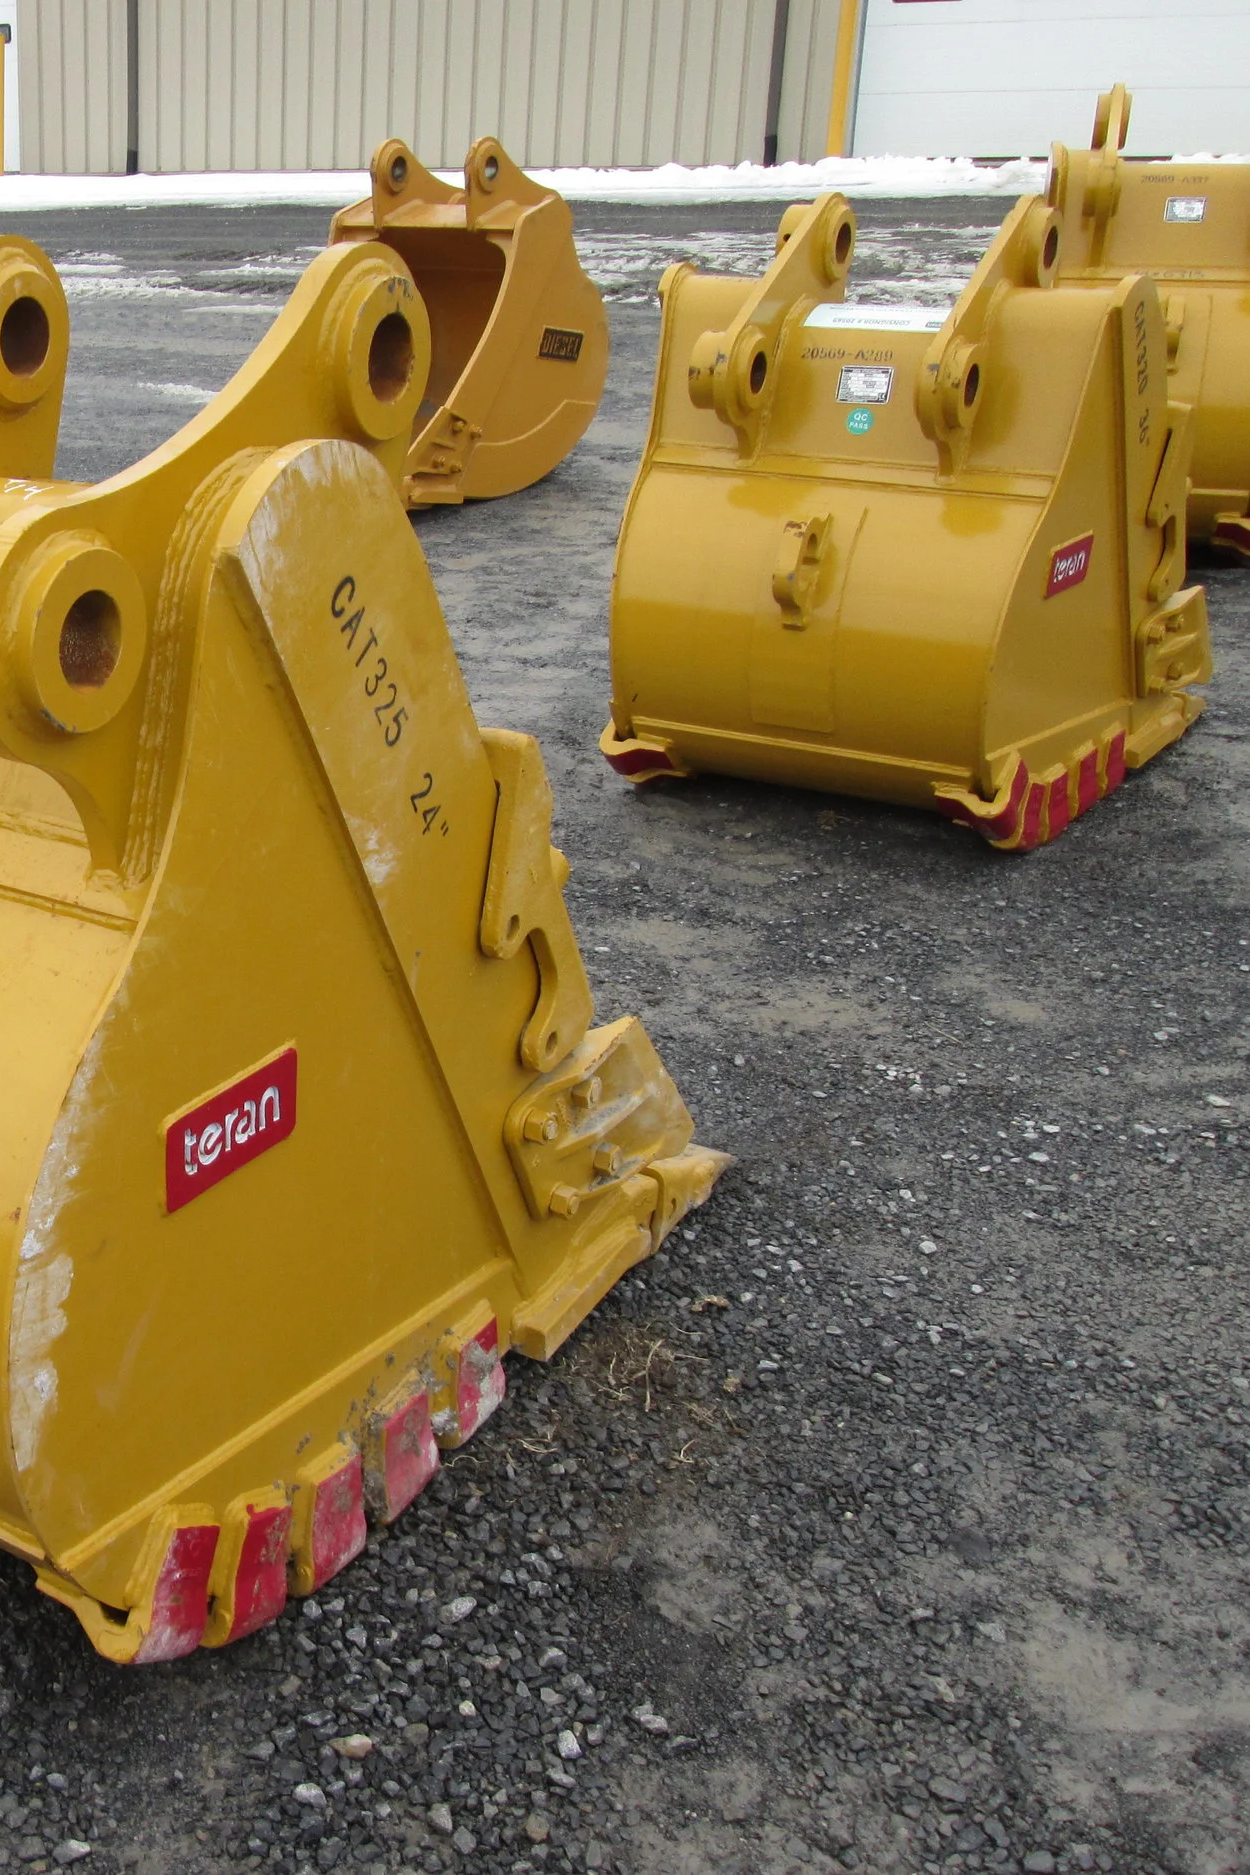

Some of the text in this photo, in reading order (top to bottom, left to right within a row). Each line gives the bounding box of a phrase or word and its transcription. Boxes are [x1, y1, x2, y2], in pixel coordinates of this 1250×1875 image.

[1134, 300, 1148, 395] CAT320
[849, 422, 868, 430] PASS
[854, 412, 869, 421] QC
[1053, 551, 1086, 583] teran
[331, 575, 449, 837] CAT325 24"
[184, 1085, 281, 1176] teran
